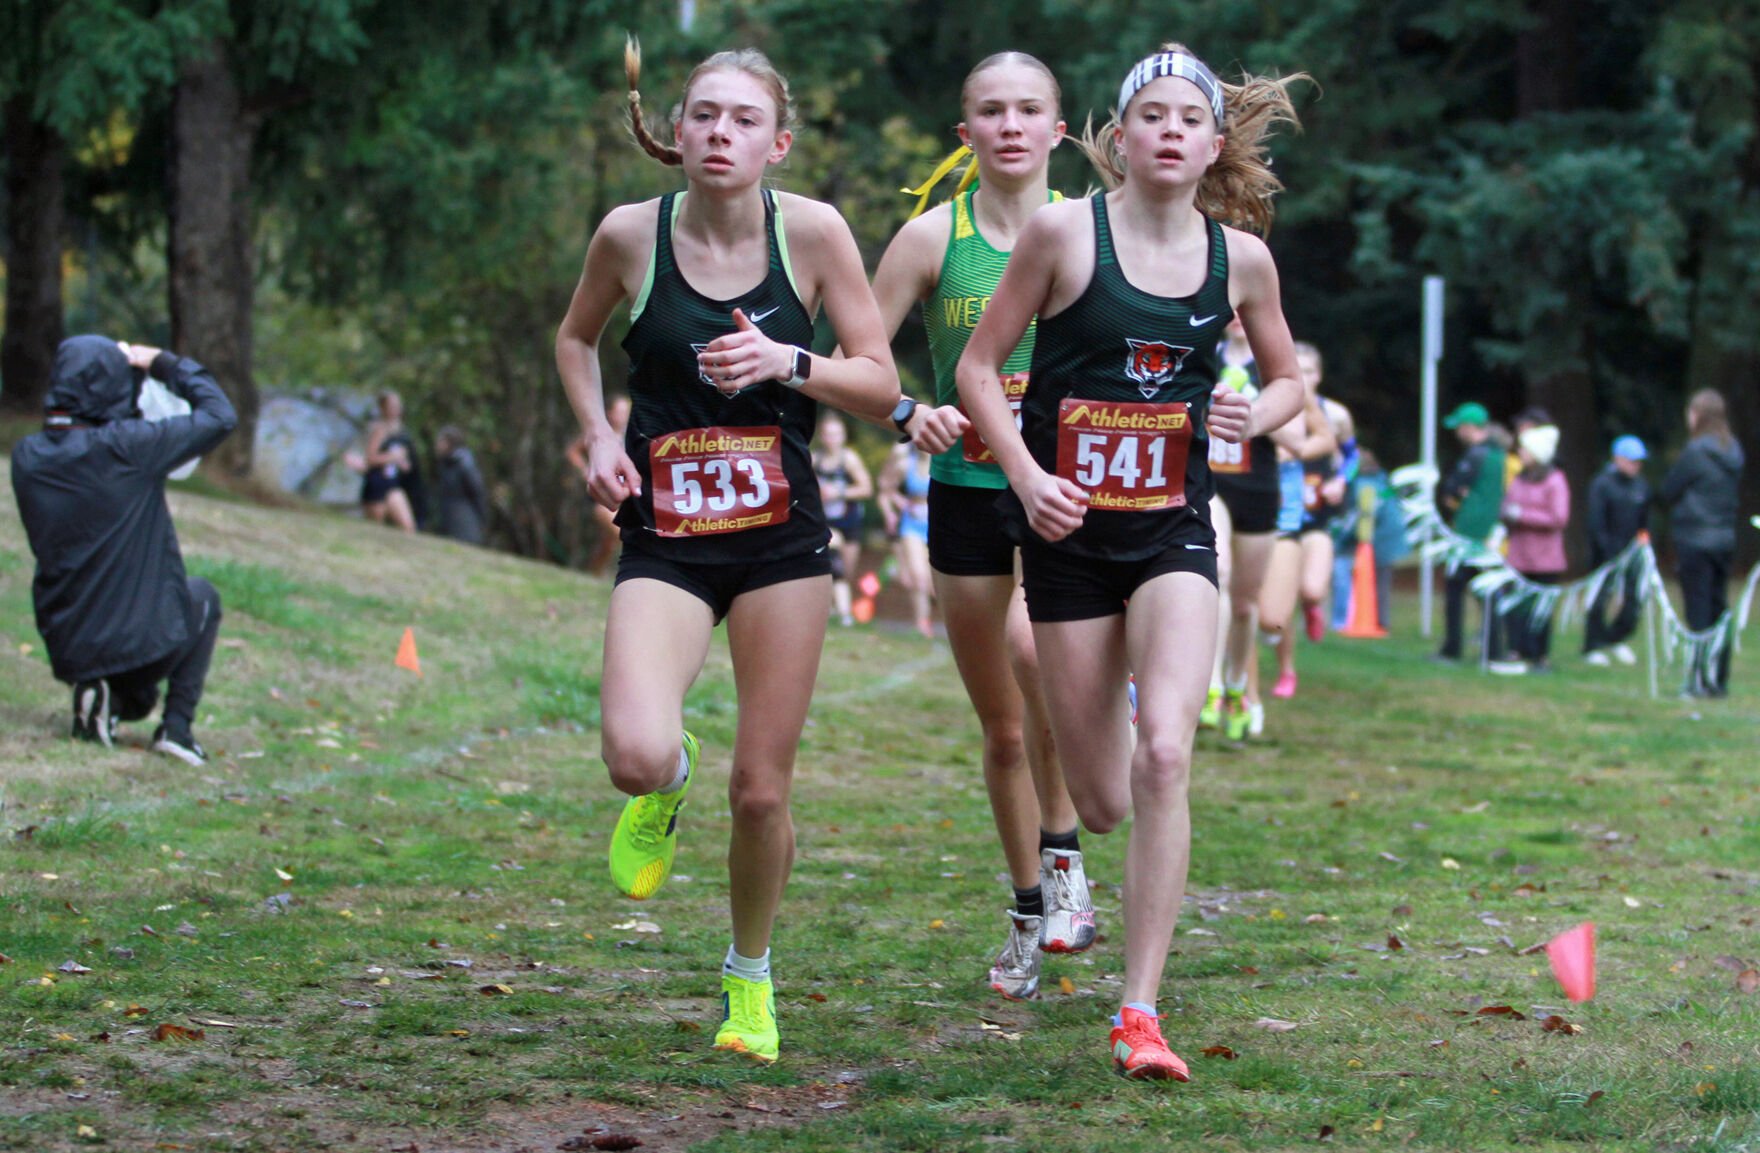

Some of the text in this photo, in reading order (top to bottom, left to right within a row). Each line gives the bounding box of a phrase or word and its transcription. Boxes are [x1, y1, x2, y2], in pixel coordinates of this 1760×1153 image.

[1063, 405, 1157, 428] Athletic
[655, 434, 743, 456] Athletic
[1075, 433, 1168, 488] 541
[671, 458, 770, 514] 533
[1088, 491, 1136, 508] thletic
[673, 517, 737, 534] Athletic
